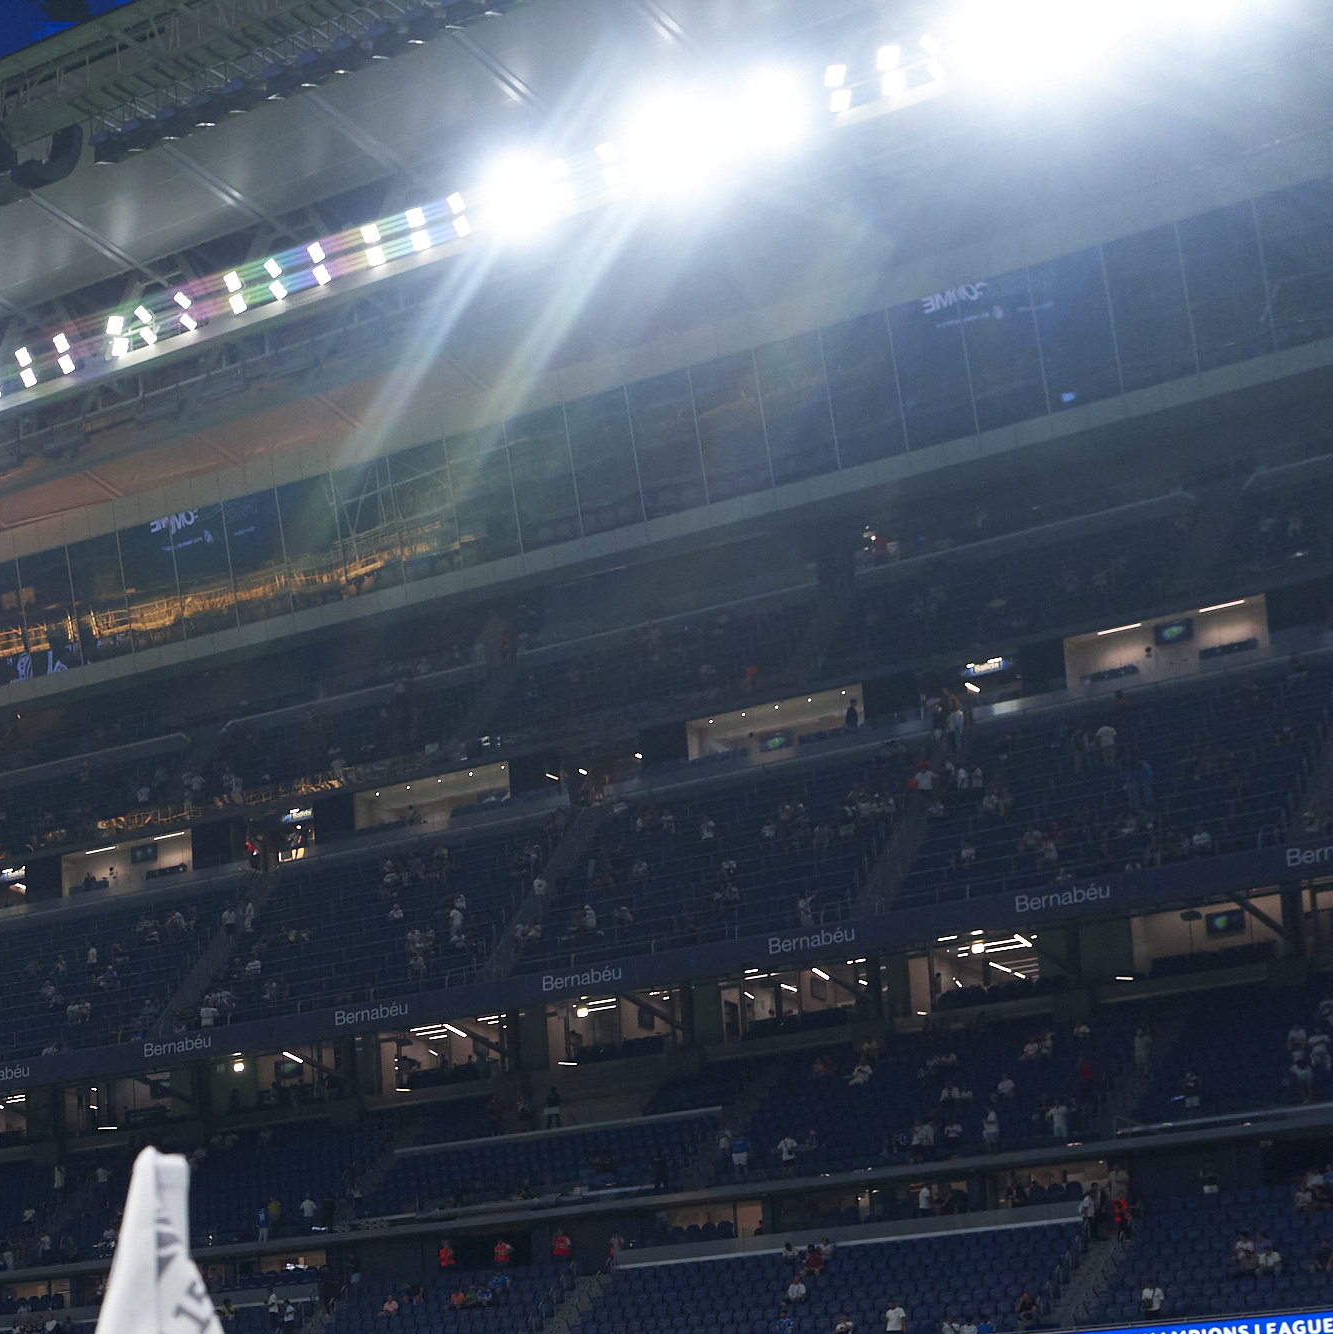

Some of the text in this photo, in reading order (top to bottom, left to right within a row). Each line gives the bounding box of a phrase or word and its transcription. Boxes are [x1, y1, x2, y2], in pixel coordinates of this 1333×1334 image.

[1015, 884, 1110, 913] Bernabéu
[768, 927, 855, 955] Bernabéu
[542, 965, 622, 992] Bernabéu
[334, 1001, 407, 1026] Bernabéu
[143, 1034, 212, 1057] Bernabéu
